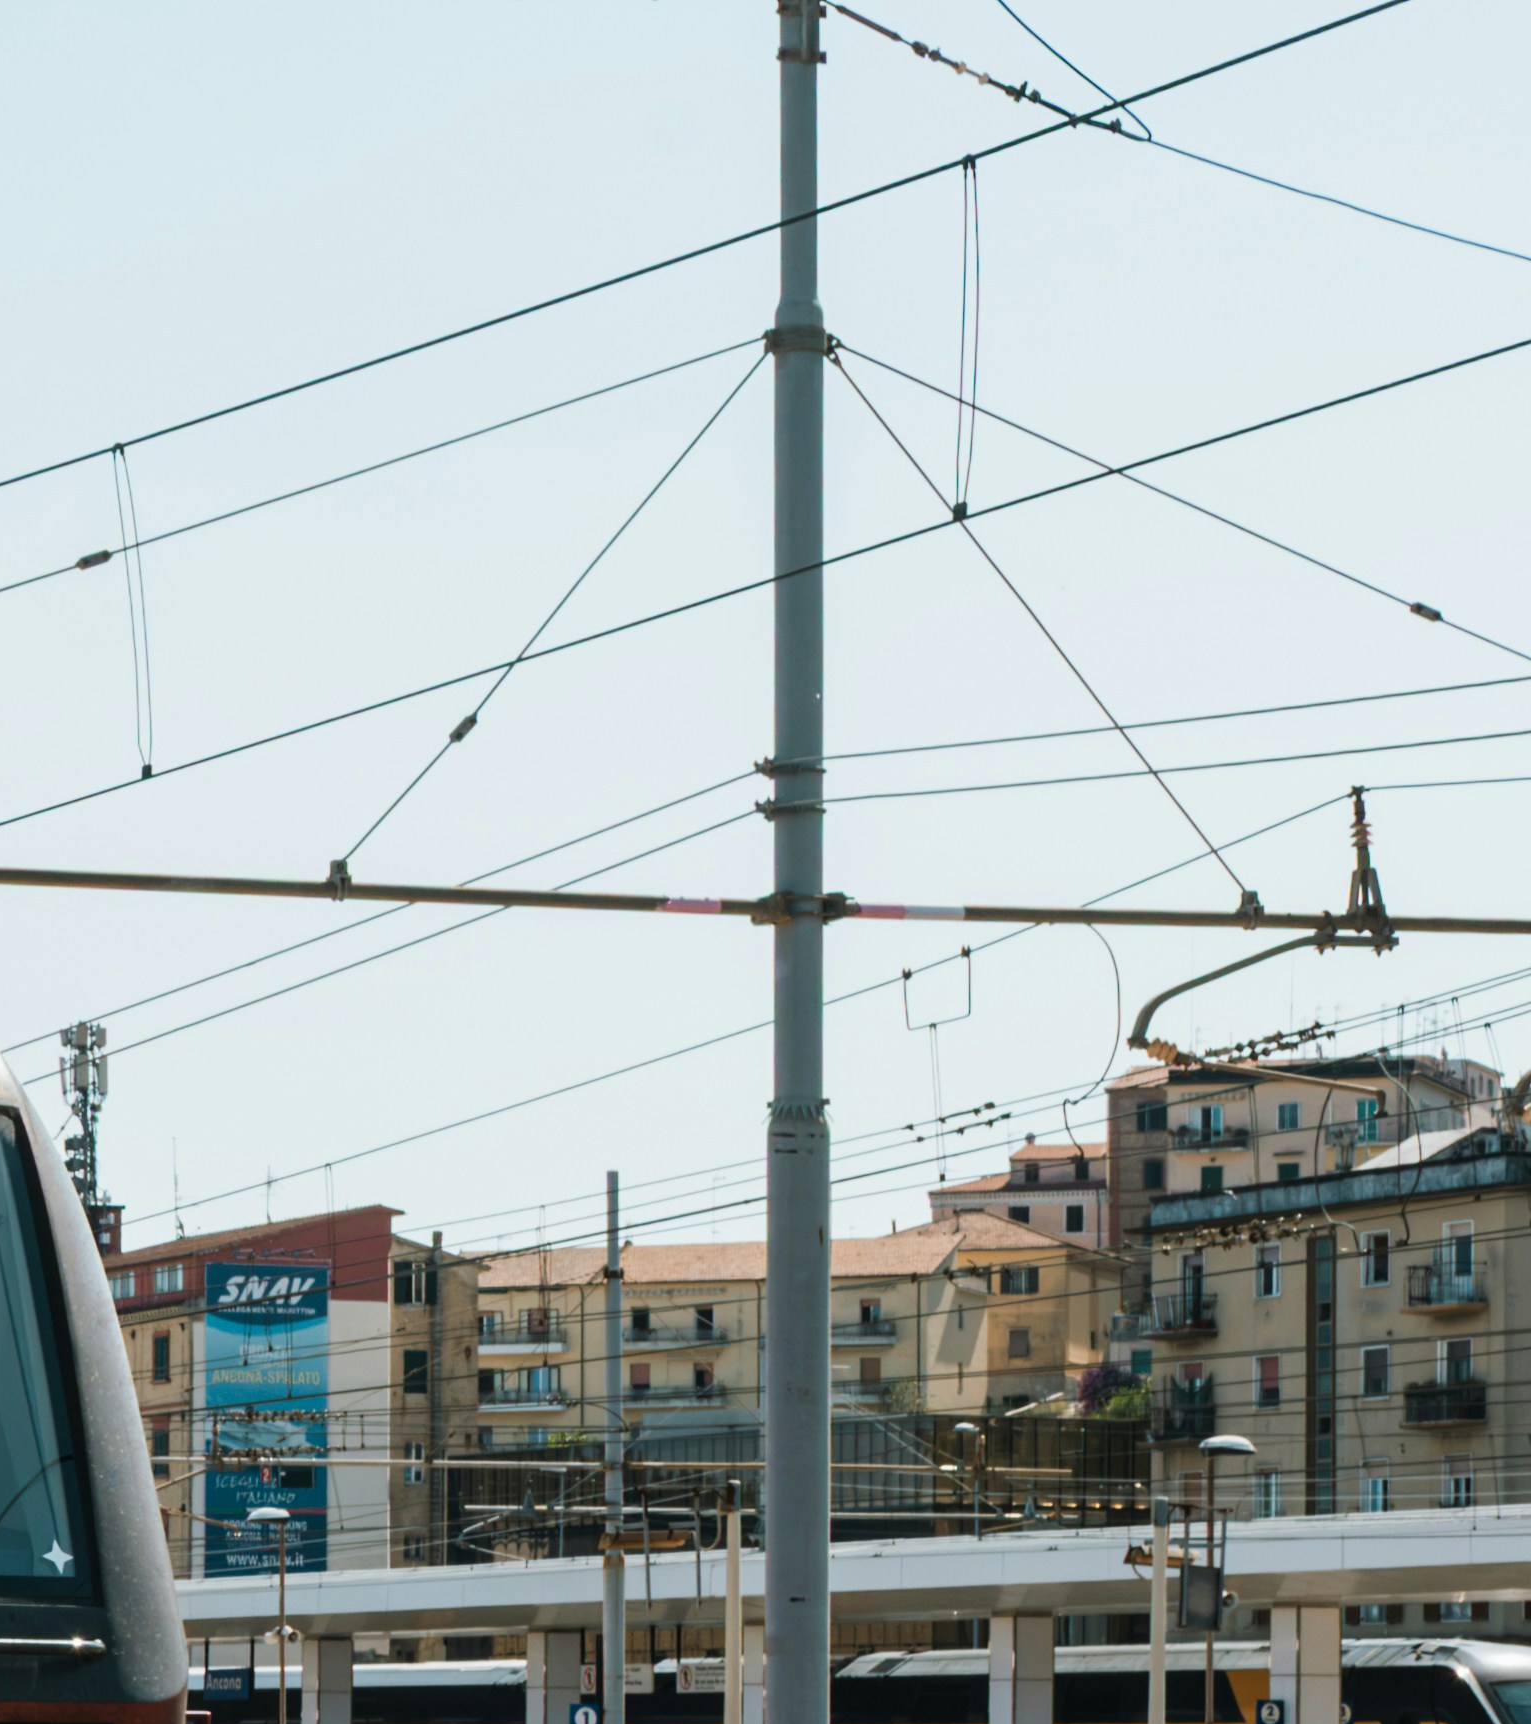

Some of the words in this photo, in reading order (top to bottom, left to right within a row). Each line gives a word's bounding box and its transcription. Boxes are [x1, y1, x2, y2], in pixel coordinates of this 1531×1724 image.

[218, 1275, 316, 1305] SNAV
[211, 1369, 320, 1386] ANCONA-SPALATO
[236, 1490, 296, 1505] ITALIANO
[225, 1552, 305, 1567] www.snv.it
[205, 1672, 242, 1691] Ancona
[1265, 1705, 1275, 1717] 2
